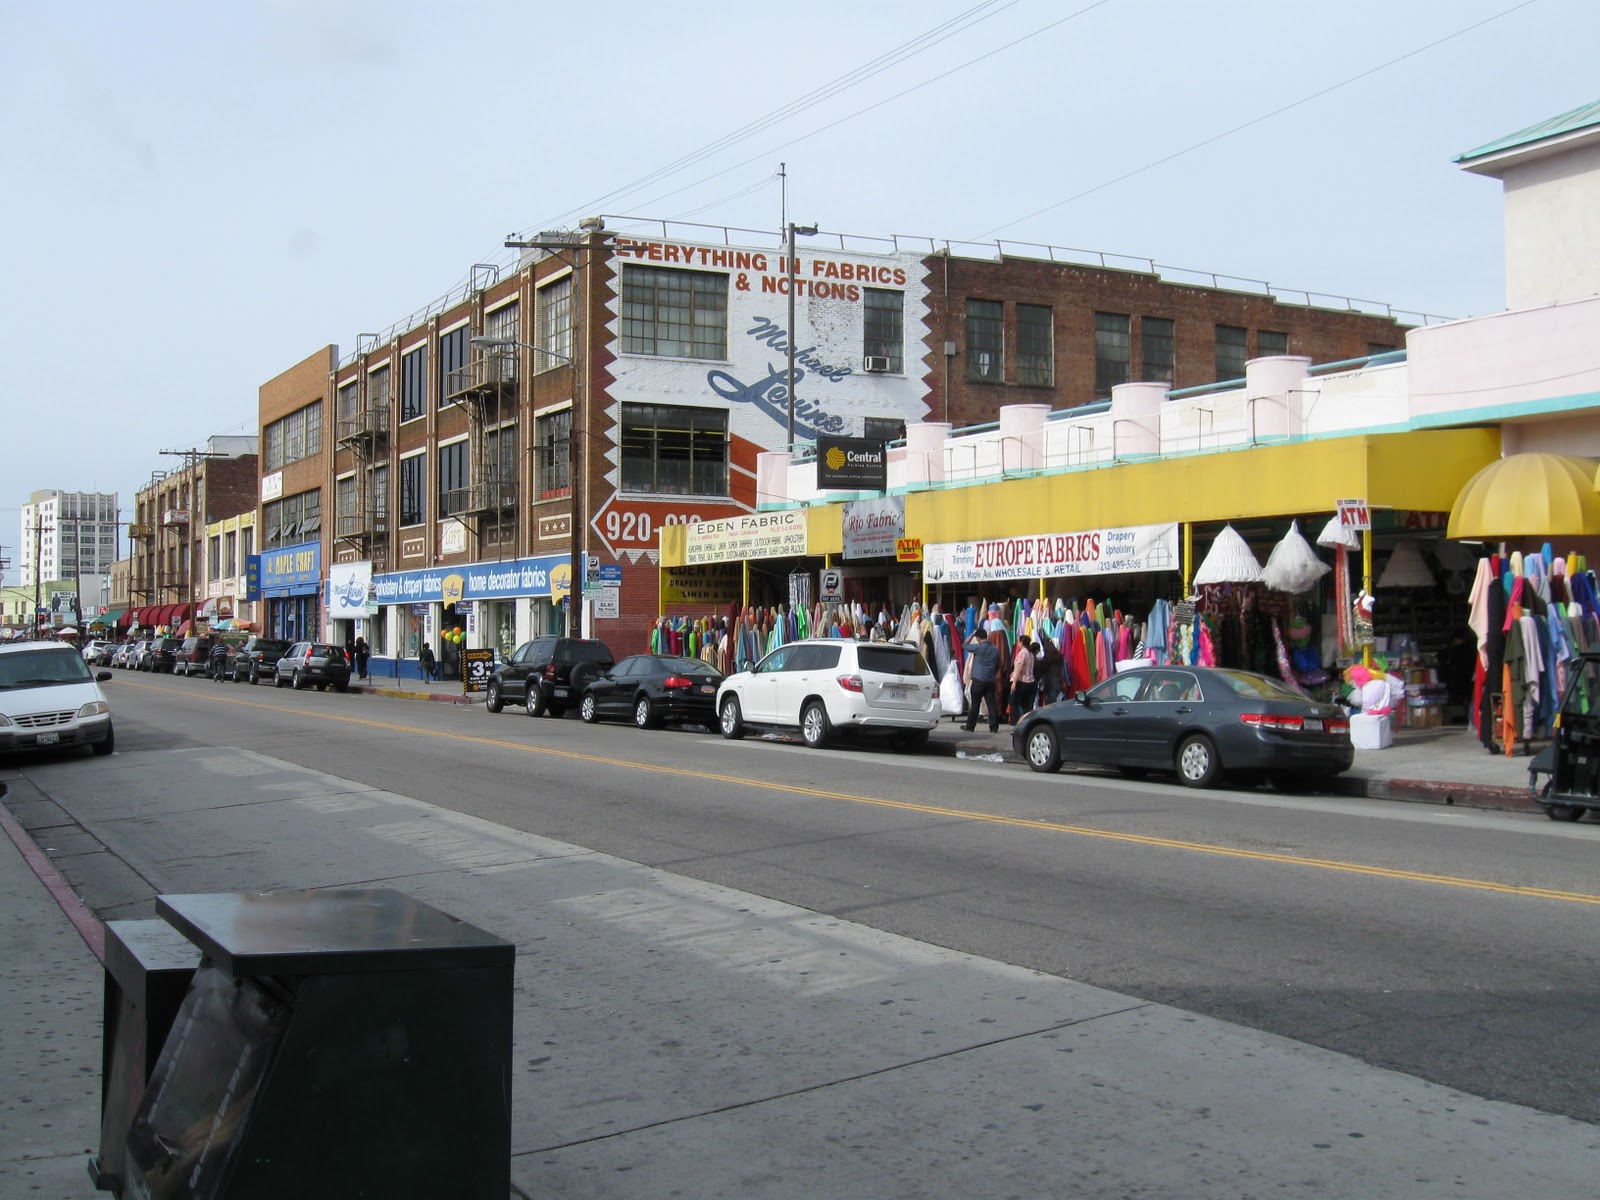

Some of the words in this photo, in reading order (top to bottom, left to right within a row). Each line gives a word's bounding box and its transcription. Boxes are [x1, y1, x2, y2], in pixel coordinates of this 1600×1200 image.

[616, 238, 768, 272] EVERYTHING
[779, 256, 801, 275] IN
[813, 260, 907, 286] FABRICS
[735, 272, 751, 291] &
[761, 276, 861, 302] NOTIONS
[847, 450, 882, 463] Central
[697, 521, 735, 535] EDEN
[741, 514, 794, 529] FABRIC
[848, 514, 864, 533] Rio
[866, 509, 898, 529] Fabric
[1340, 507, 1370, 526] ATM
[897, 539, 920, 548] ATM
[1107, 531, 1136, 543] Drapery
[956, 544, 973, 554] Foam
[975, 539, 1034, 568] EUROPE
[1036, 532, 1100, 564] FABRICS
[1105, 544, 1136, 557] Upholstery
[275, 553, 293, 575] MAPLE
[295, 550, 315, 573] CRAFT
[952, 555, 975, 566] Trimming
[468, 571, 487, 592] home
[487, 570, 521, 591] decorator
[521, 565, 547, 588] fabrics
[966, 569, 981, 580] Maple
[994, 566, 1042, 578] WHOLESALE
[1045, 565, 1051, 576] &
[1054, 563, 1082, 574] RETAIL
[376, 579, 399, 600] pholstery
[398, 576, 403, 595] &
[403, 576, 423, 598] drapery
[423, 573, 442, 593] fabrics
[669, 579, 703, 588] DRAPERY
